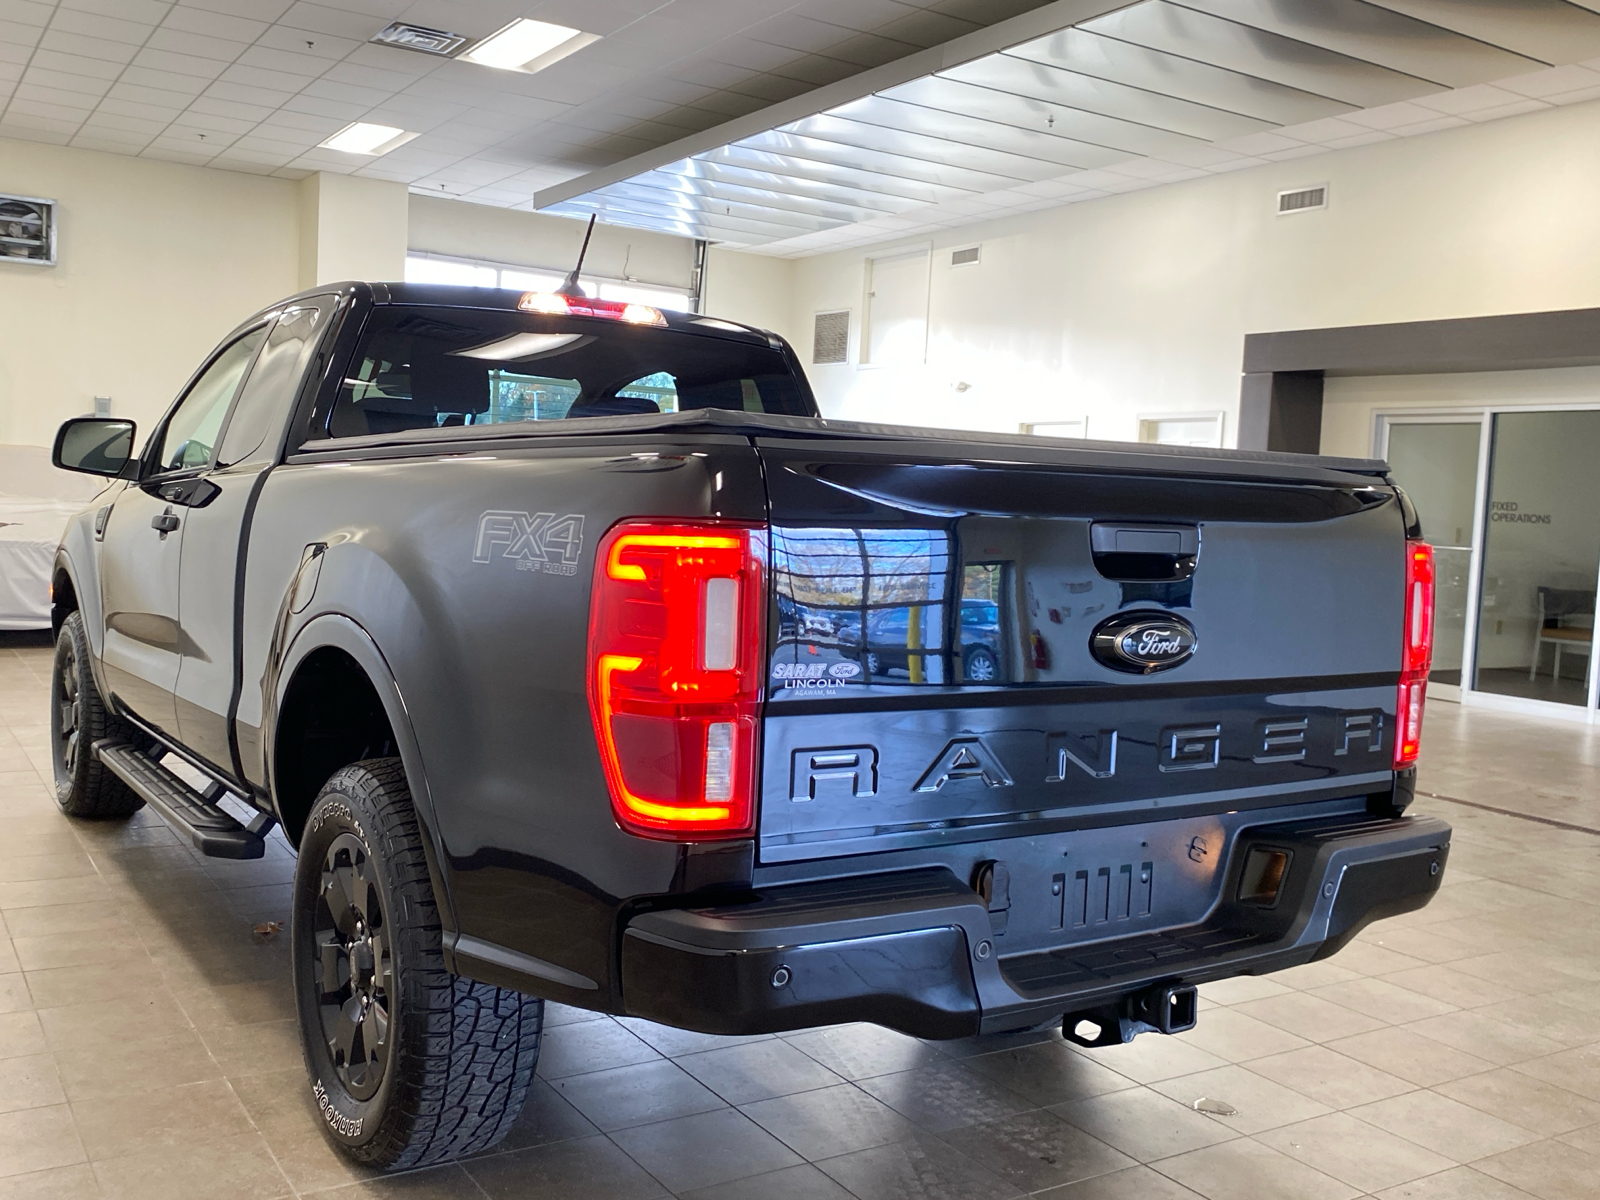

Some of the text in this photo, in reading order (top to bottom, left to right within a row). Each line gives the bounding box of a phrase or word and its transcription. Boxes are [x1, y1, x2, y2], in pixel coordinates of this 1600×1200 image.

[1492, 502, 1518, 511] FIXED
[1491, 512, 1551, 524] OPERATIONS
[472, 510, 585, 565] FX4
[516, 560, 577, 576] OFF ROAD
[1138, 629, 1181, 655] Ford
[772, 663, 827, 679] SARAT
[784, 679, 846, 689] LINCOLN
[789, 708, 1384, 803] RANGER
